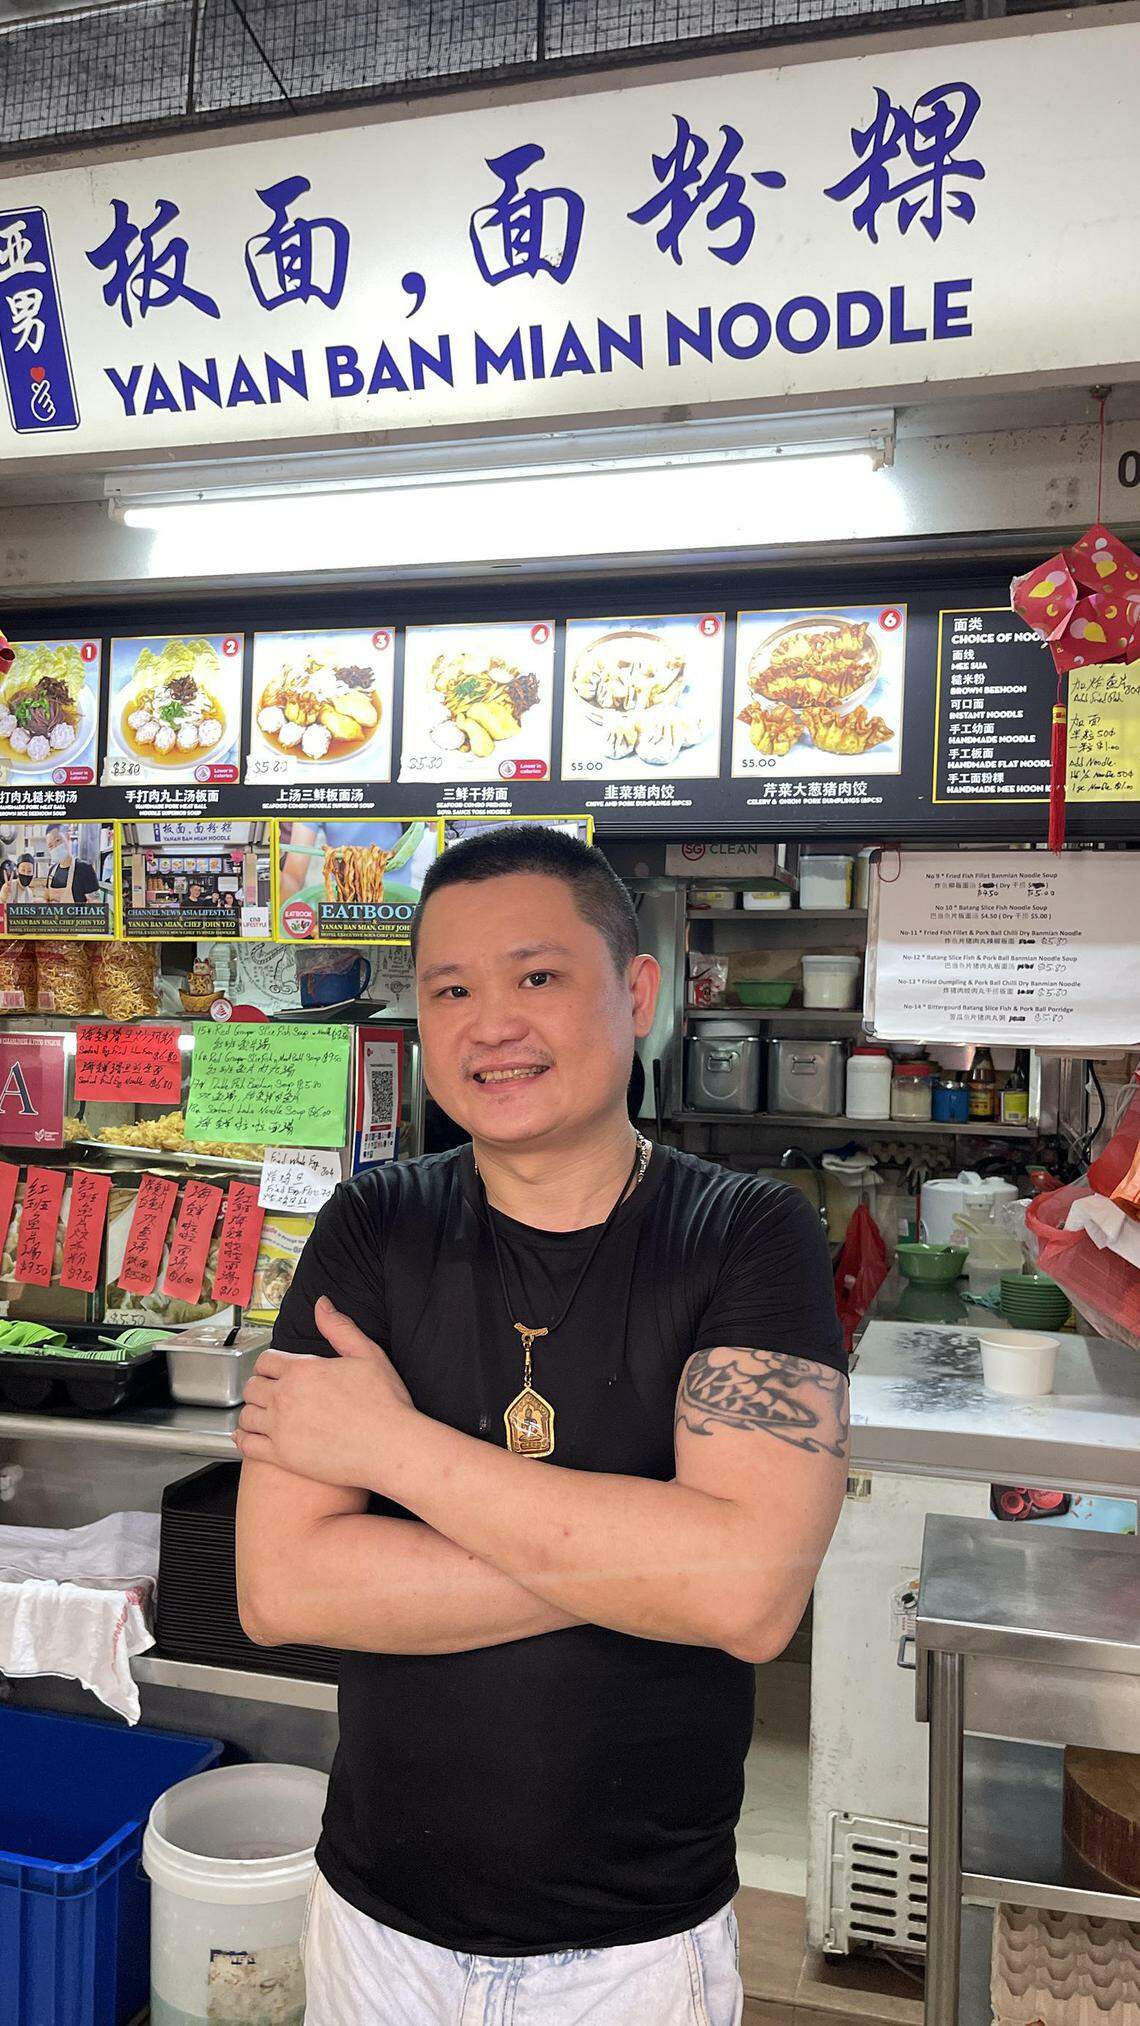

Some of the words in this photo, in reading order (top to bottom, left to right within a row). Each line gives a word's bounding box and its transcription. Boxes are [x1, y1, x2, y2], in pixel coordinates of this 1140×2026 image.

[104, 345, 307, 416] YANAN
[327, 333, 453, 398] BAN
[475, 313, 644, 385] MIAN
[666, 278, 974, 365] NOODLE
[953, 617, 983, 632] 面类
[951, 633, 995, 645] CHOICE
[996, 632, 1013, 643] OF
[1014, 632, 1043, 642] NOO
[952, 649, 975, 661] 面线
[951, 662, 969, 670] MEE
[970, 661, 988, 670] SUA
[950, 687, 983, 695] BROWN
[984, 685, 1027, 694] BEEHOON
[950, 698, 984, 710] 可口面
[949, 711, 986, 720] INSTANT
[986, 710, 1024, 719] NOODLE
[949, 723, 995, 735] 手工幼面
[948, 736, 998, 744] HANDMADE
[999, 735, 1037, 743] NOODLE
[948, 748, 994, 760] 手工板面
[571, 762, 603, 771] $5.00
[741, 759, 776, 769] $5.00
[947, 760, 997, 769] HANDMADE
[998, 760, 1020, 769] FLAT
[1020, 760, 1054, 768] NOODL
[948, 772, 1005, 785] 手工面粉粿
[276, 788, 364, 802] 上汤三鲜板面汤
[442, 786, 509, 801] 三鲜干捞面
[603, 784, 675, 800] 韭菜猪肉饺
[763, 781, 868, 798] 芹菜大葱猪肉饺
[946, 785, 996, 794] HANDMADE
[997, 785, 1016, 793] MEE
[1016, 784, 1044, 793] HOON
[124, 789, 220, 803] 手打肉丸上汤板面
[1042, 872, 1058, 880] Soup
[9, 906, 36, 915] MISS
[39, 906, 64, 915] TAM
[66, 906, 105, 915] CHIAK
[321, 904, 416, 919] EATBOO
[0, 1061, 39, 1115] A
